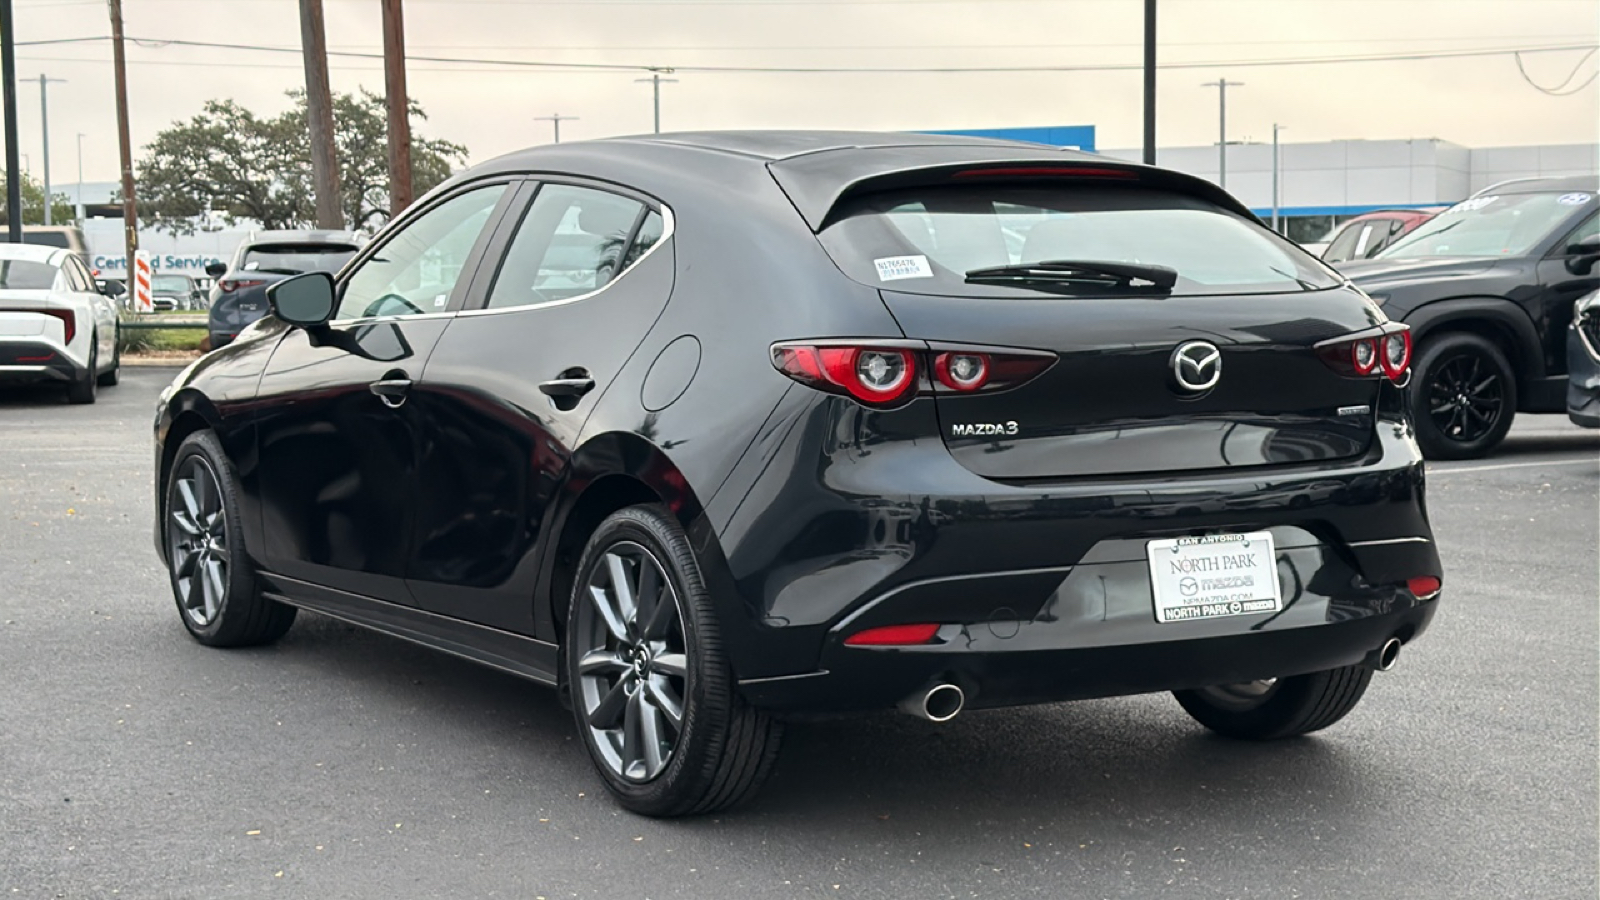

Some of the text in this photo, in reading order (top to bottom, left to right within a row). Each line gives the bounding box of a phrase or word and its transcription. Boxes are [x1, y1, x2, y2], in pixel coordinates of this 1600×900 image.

[95, 255, 160, 269] Certd
[1179, 534, 1243, 546] SAN ANTONIO
[1170, 553, 1257, 574] NORTH PARK
[1201, 575, 1254, 591] mazda
[1165, 607, 1201, 620] NORTH
[1203, 603, 1230, 616] PARK
